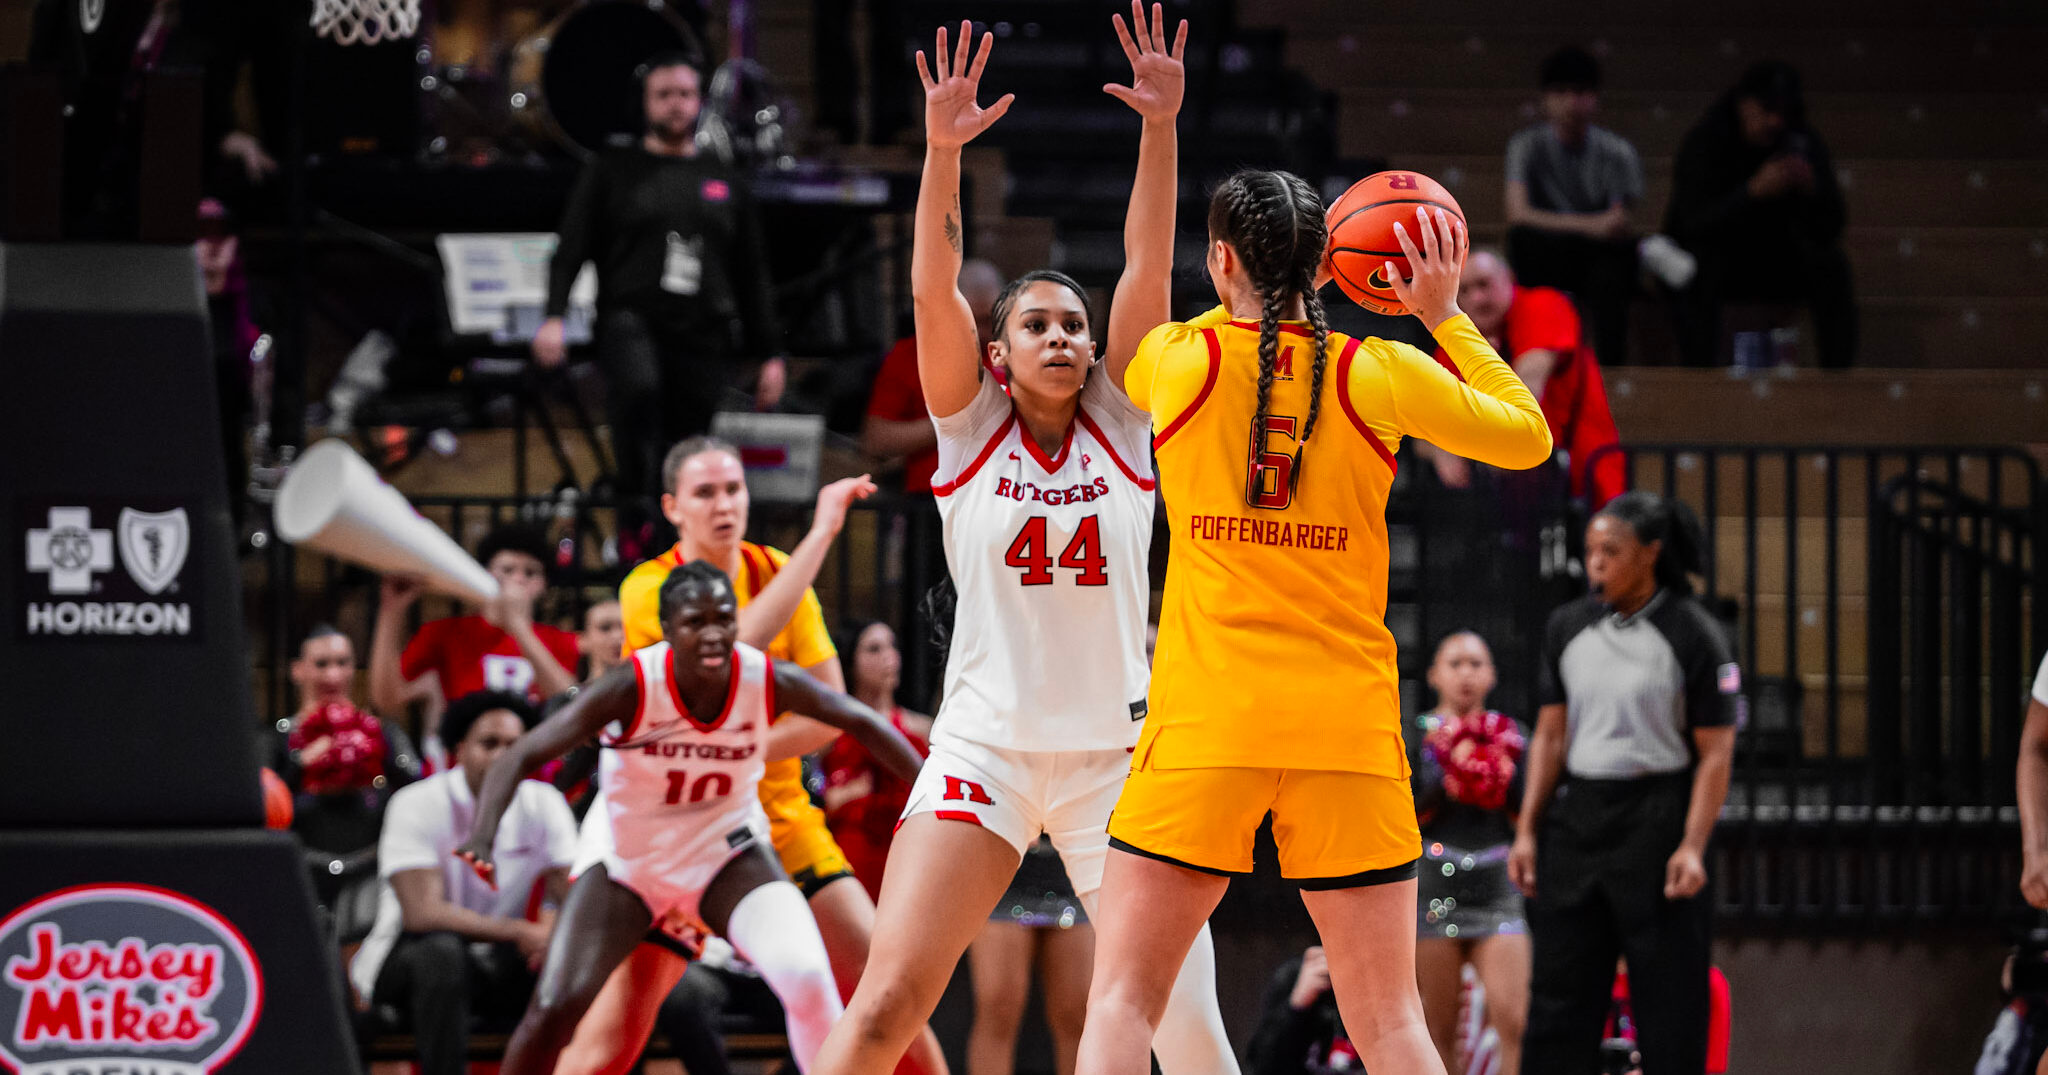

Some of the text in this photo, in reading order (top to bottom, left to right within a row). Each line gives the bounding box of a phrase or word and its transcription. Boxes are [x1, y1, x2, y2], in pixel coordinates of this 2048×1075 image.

[1384, 174, 1420, 191] R
[1245, 414, 1297, 511] 6
[995, 476, 1110, 506] RUTGERS
[1004, 513, 1109, 586] 44
[1191, 515, 1349, 552] POFFENBARGER
[27, 602, 191, 635] HORIZON
[665, 769, 734, 806] 10
[10, 927, 217, 1000] Jersey
[20, 983, 213, 1044] Mike's
